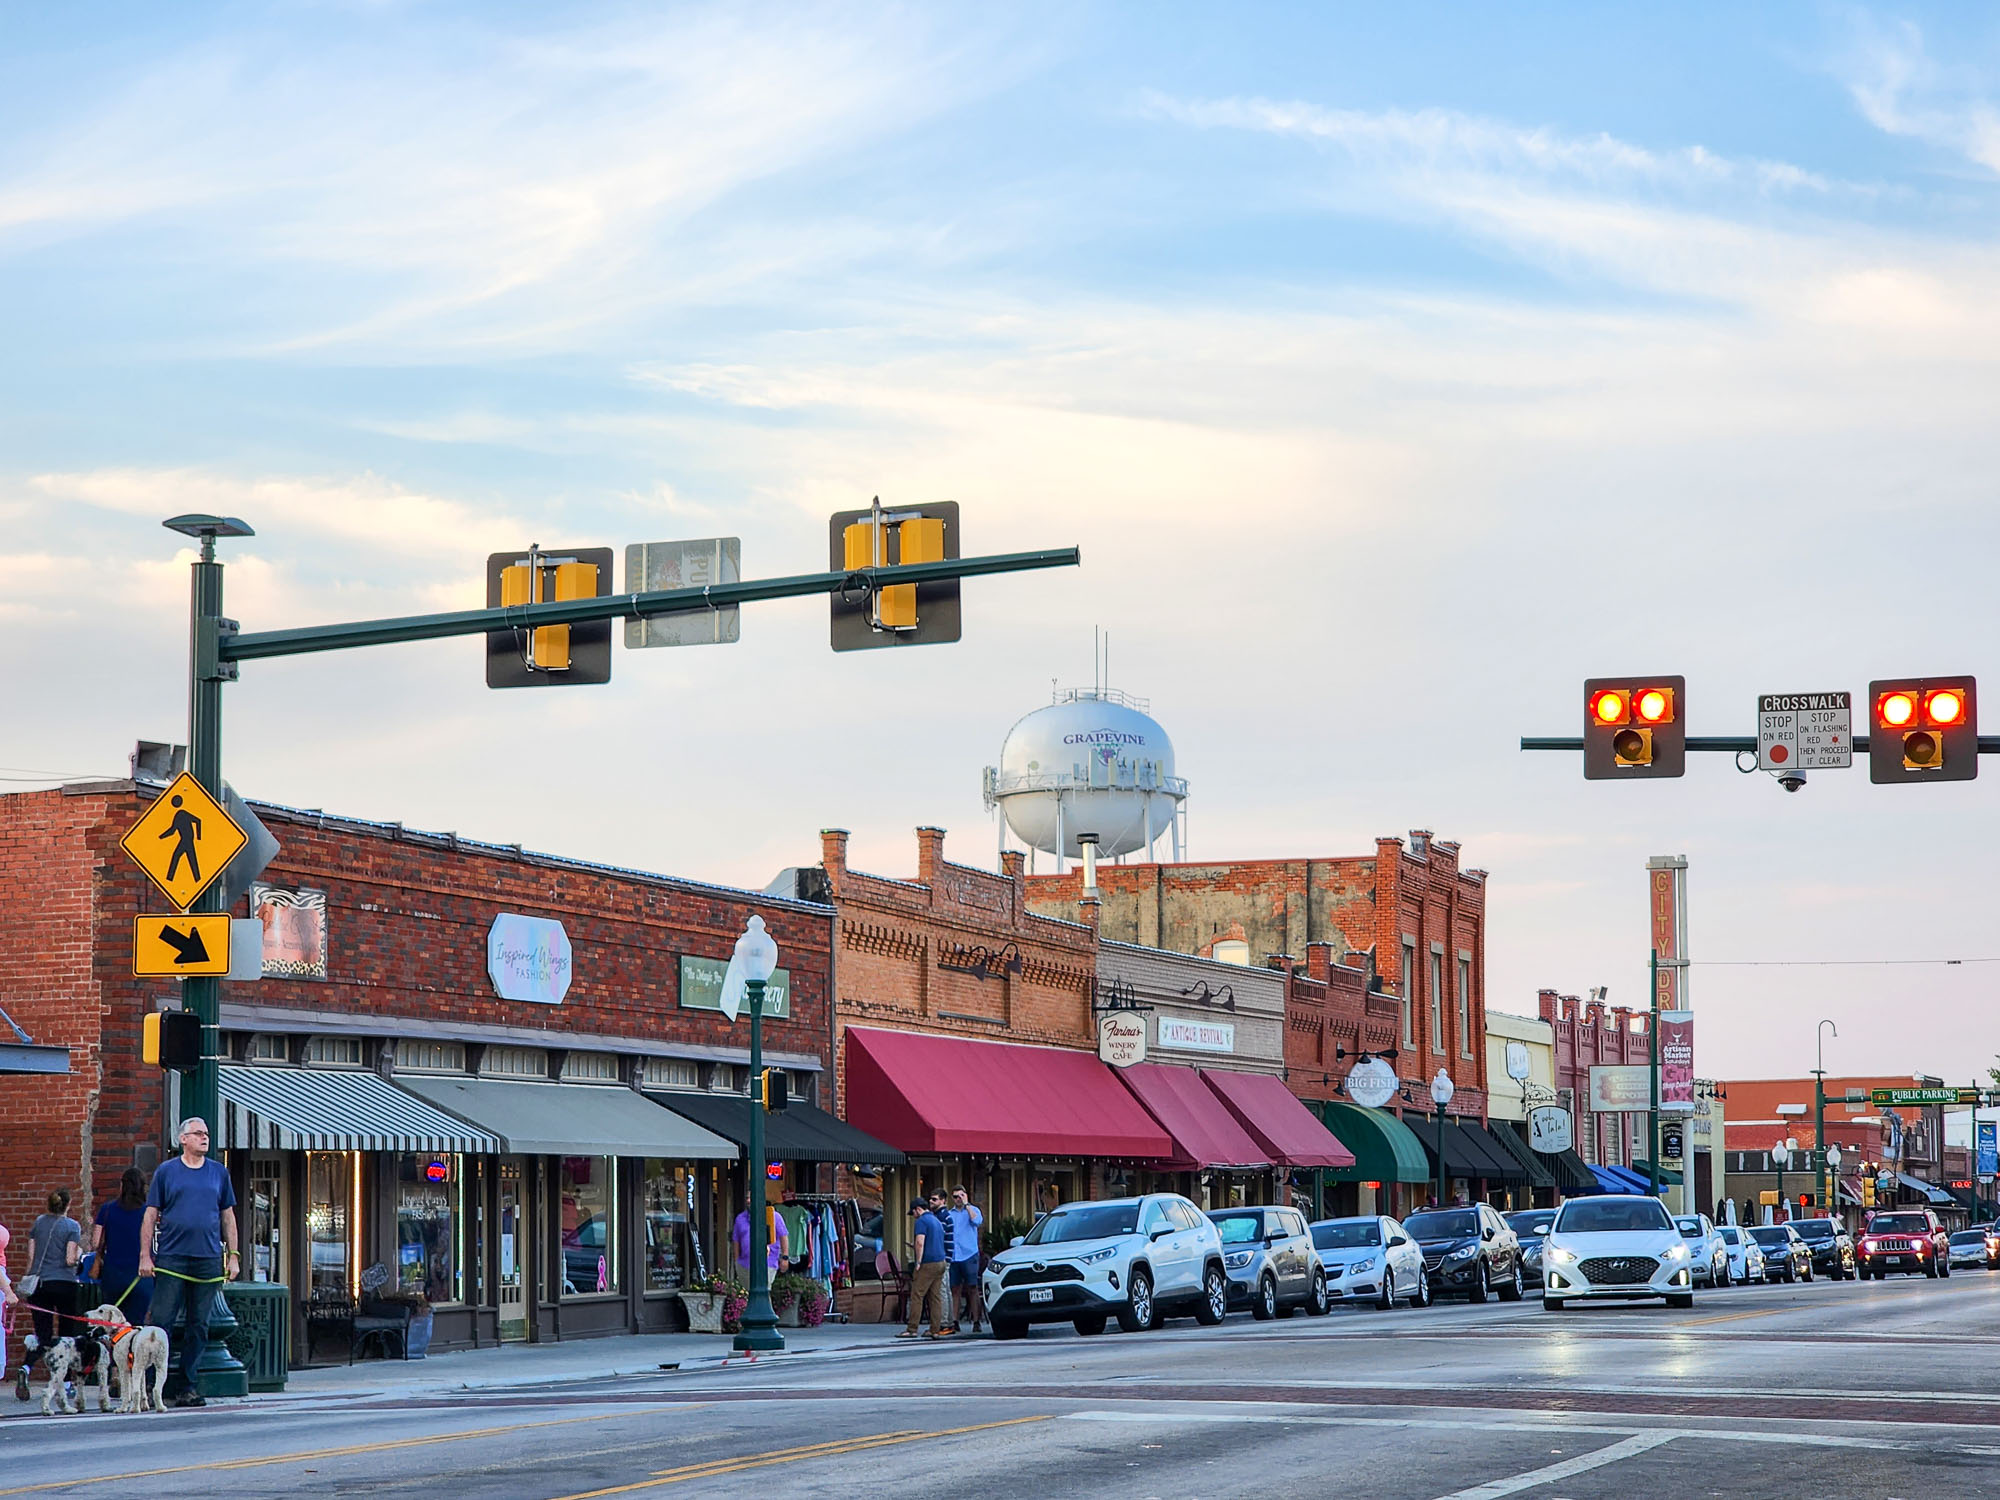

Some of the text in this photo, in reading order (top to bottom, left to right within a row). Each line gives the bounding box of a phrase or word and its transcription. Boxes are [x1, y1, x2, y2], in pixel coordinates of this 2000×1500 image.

[1764, 695, 1845, 711] CROSSWALK
[1765, 716, 1792, 728] STOP
[1811, 712, 1836, 722] STOP
[1800, 724, 1848, 733] ON FLASHING
[1063, 733, 1146, 746] GRAPEVINE
[1763, 731, 1794, 741] ON RED
[1807, 736, 1820, 744] RED
[1800, 746, 1848, 755] THEN PROCEED
[1807, 756, 1841, 765] IF CLEAR
[1655, 872, 1669, 957] CITY
[495, 942, 569, 975] Inspired Wings
[516, 968, 551, 980] FASHION
[1658, 969, 1671, 1010] DR
[1104, 1020, 1143, 1040] Farina's
[1170, 1025, 1223, 1045] ANTIQUE REVIVAL
[1109, 1042, 1137, 1050] WINERY
[1663, 1045, 1691, 1053] Artisan
[1112, 1052, 1133, 1060] CAFE
[1348, 1077, 1395, 1088] BIG FISH
[1892, 1089, 1956, 1099] PUBLIC PARKING
[236, 1310, 267, 1322] EVINE
